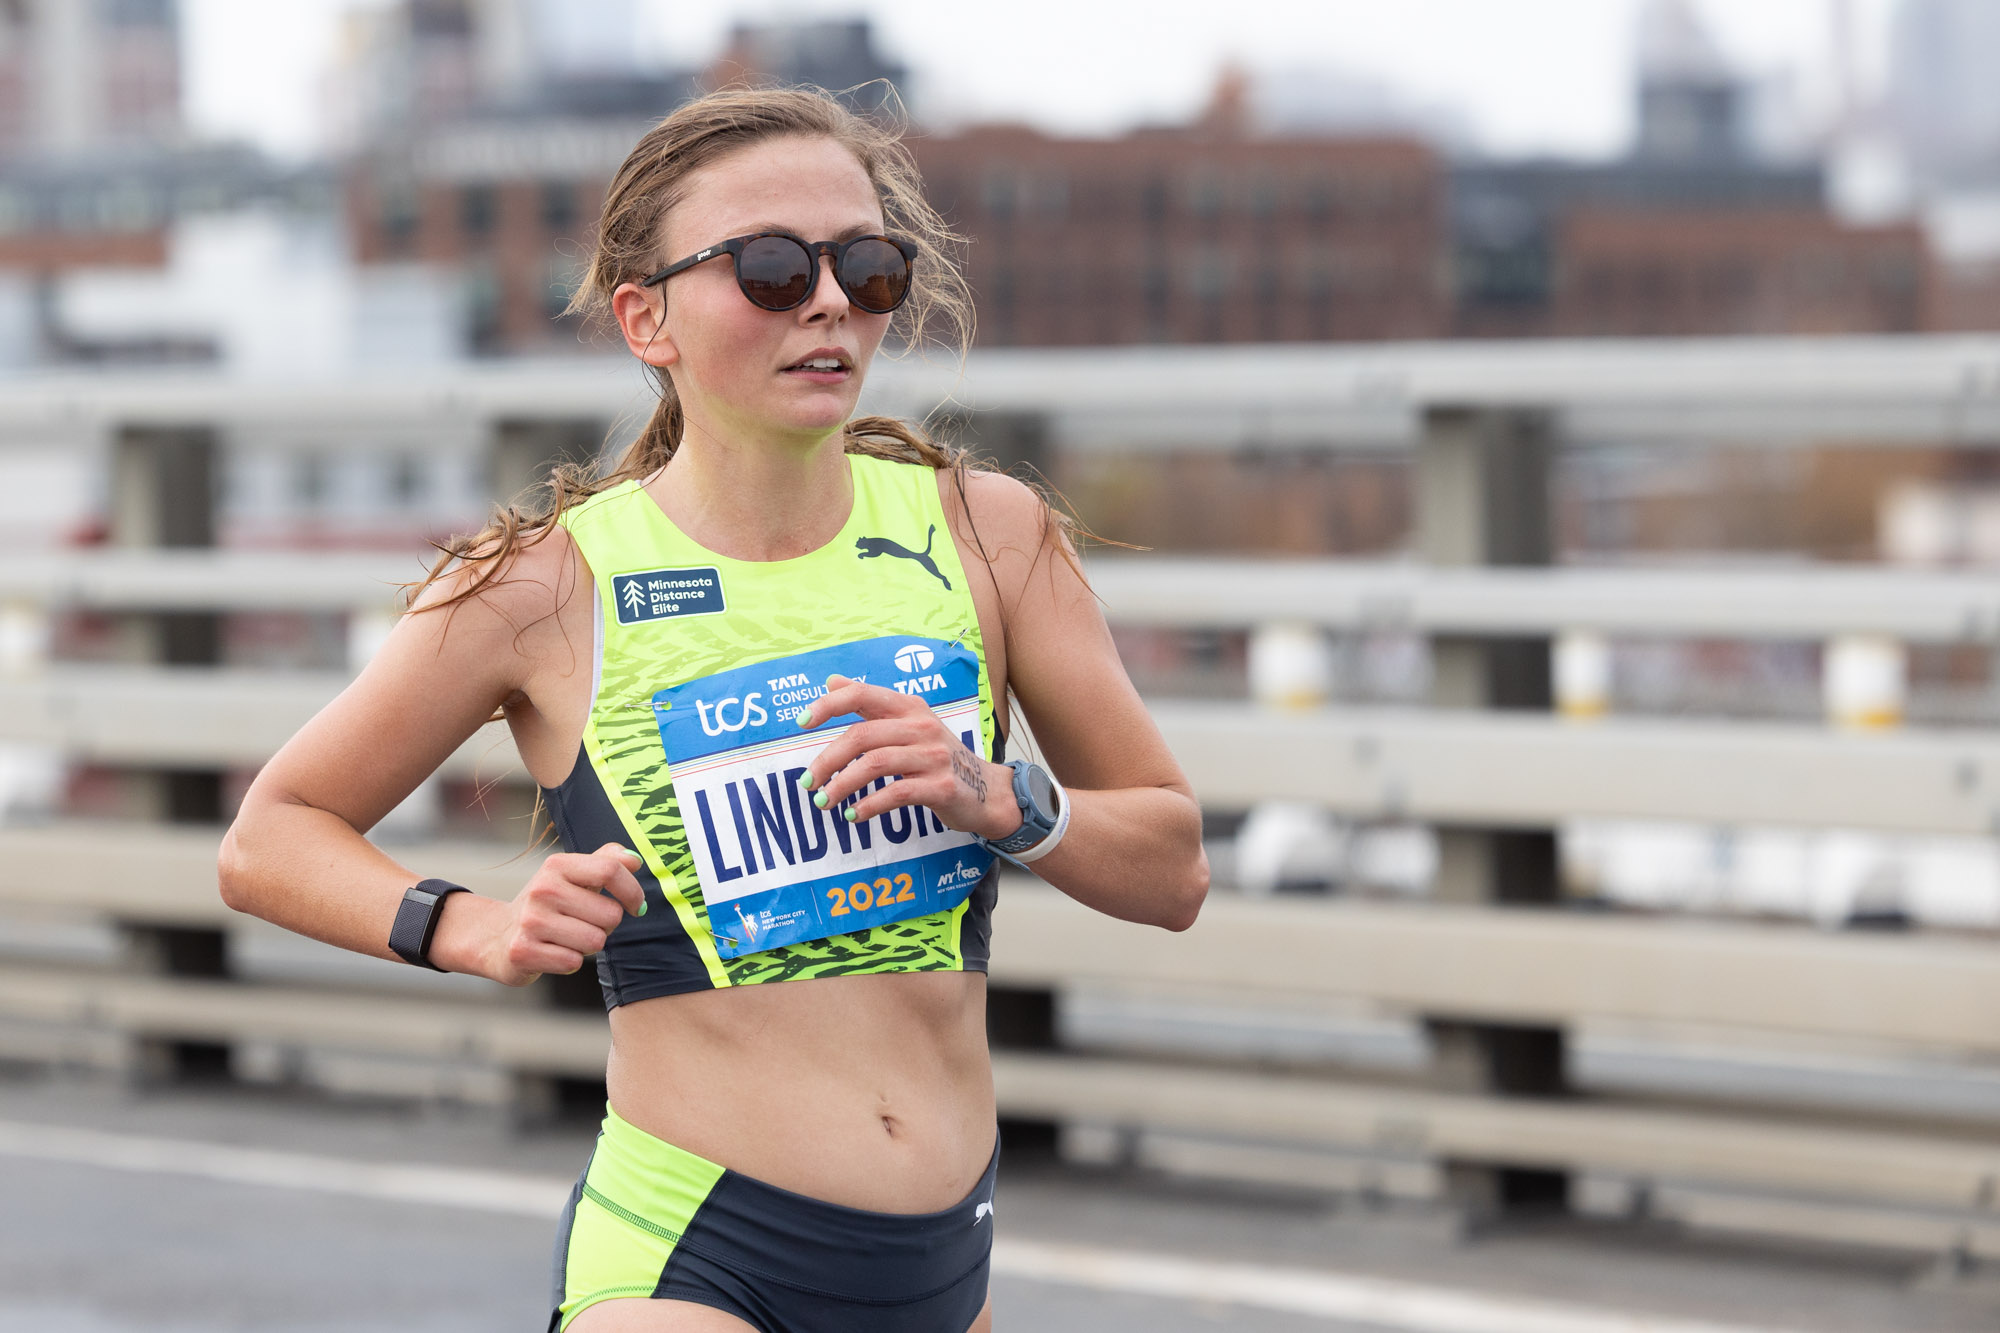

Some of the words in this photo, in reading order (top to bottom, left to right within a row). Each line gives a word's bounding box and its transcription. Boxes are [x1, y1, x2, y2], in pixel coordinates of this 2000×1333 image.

[648, 578, 713, 591] Minnesota
[650, 590, 705, 603] Distance
[652, 603, 680, 615] Elite
[767, 673, 810, 691] TATA
[893, 673, 947, 695] TATA
[695, 692, 768, 737] tcs
[826, 873, 915, 917] 2022
[762, 917, 776, 925] NEW
[792, 910, 806, 918] CITY
[762, 919, 795, 931] MARATHON
